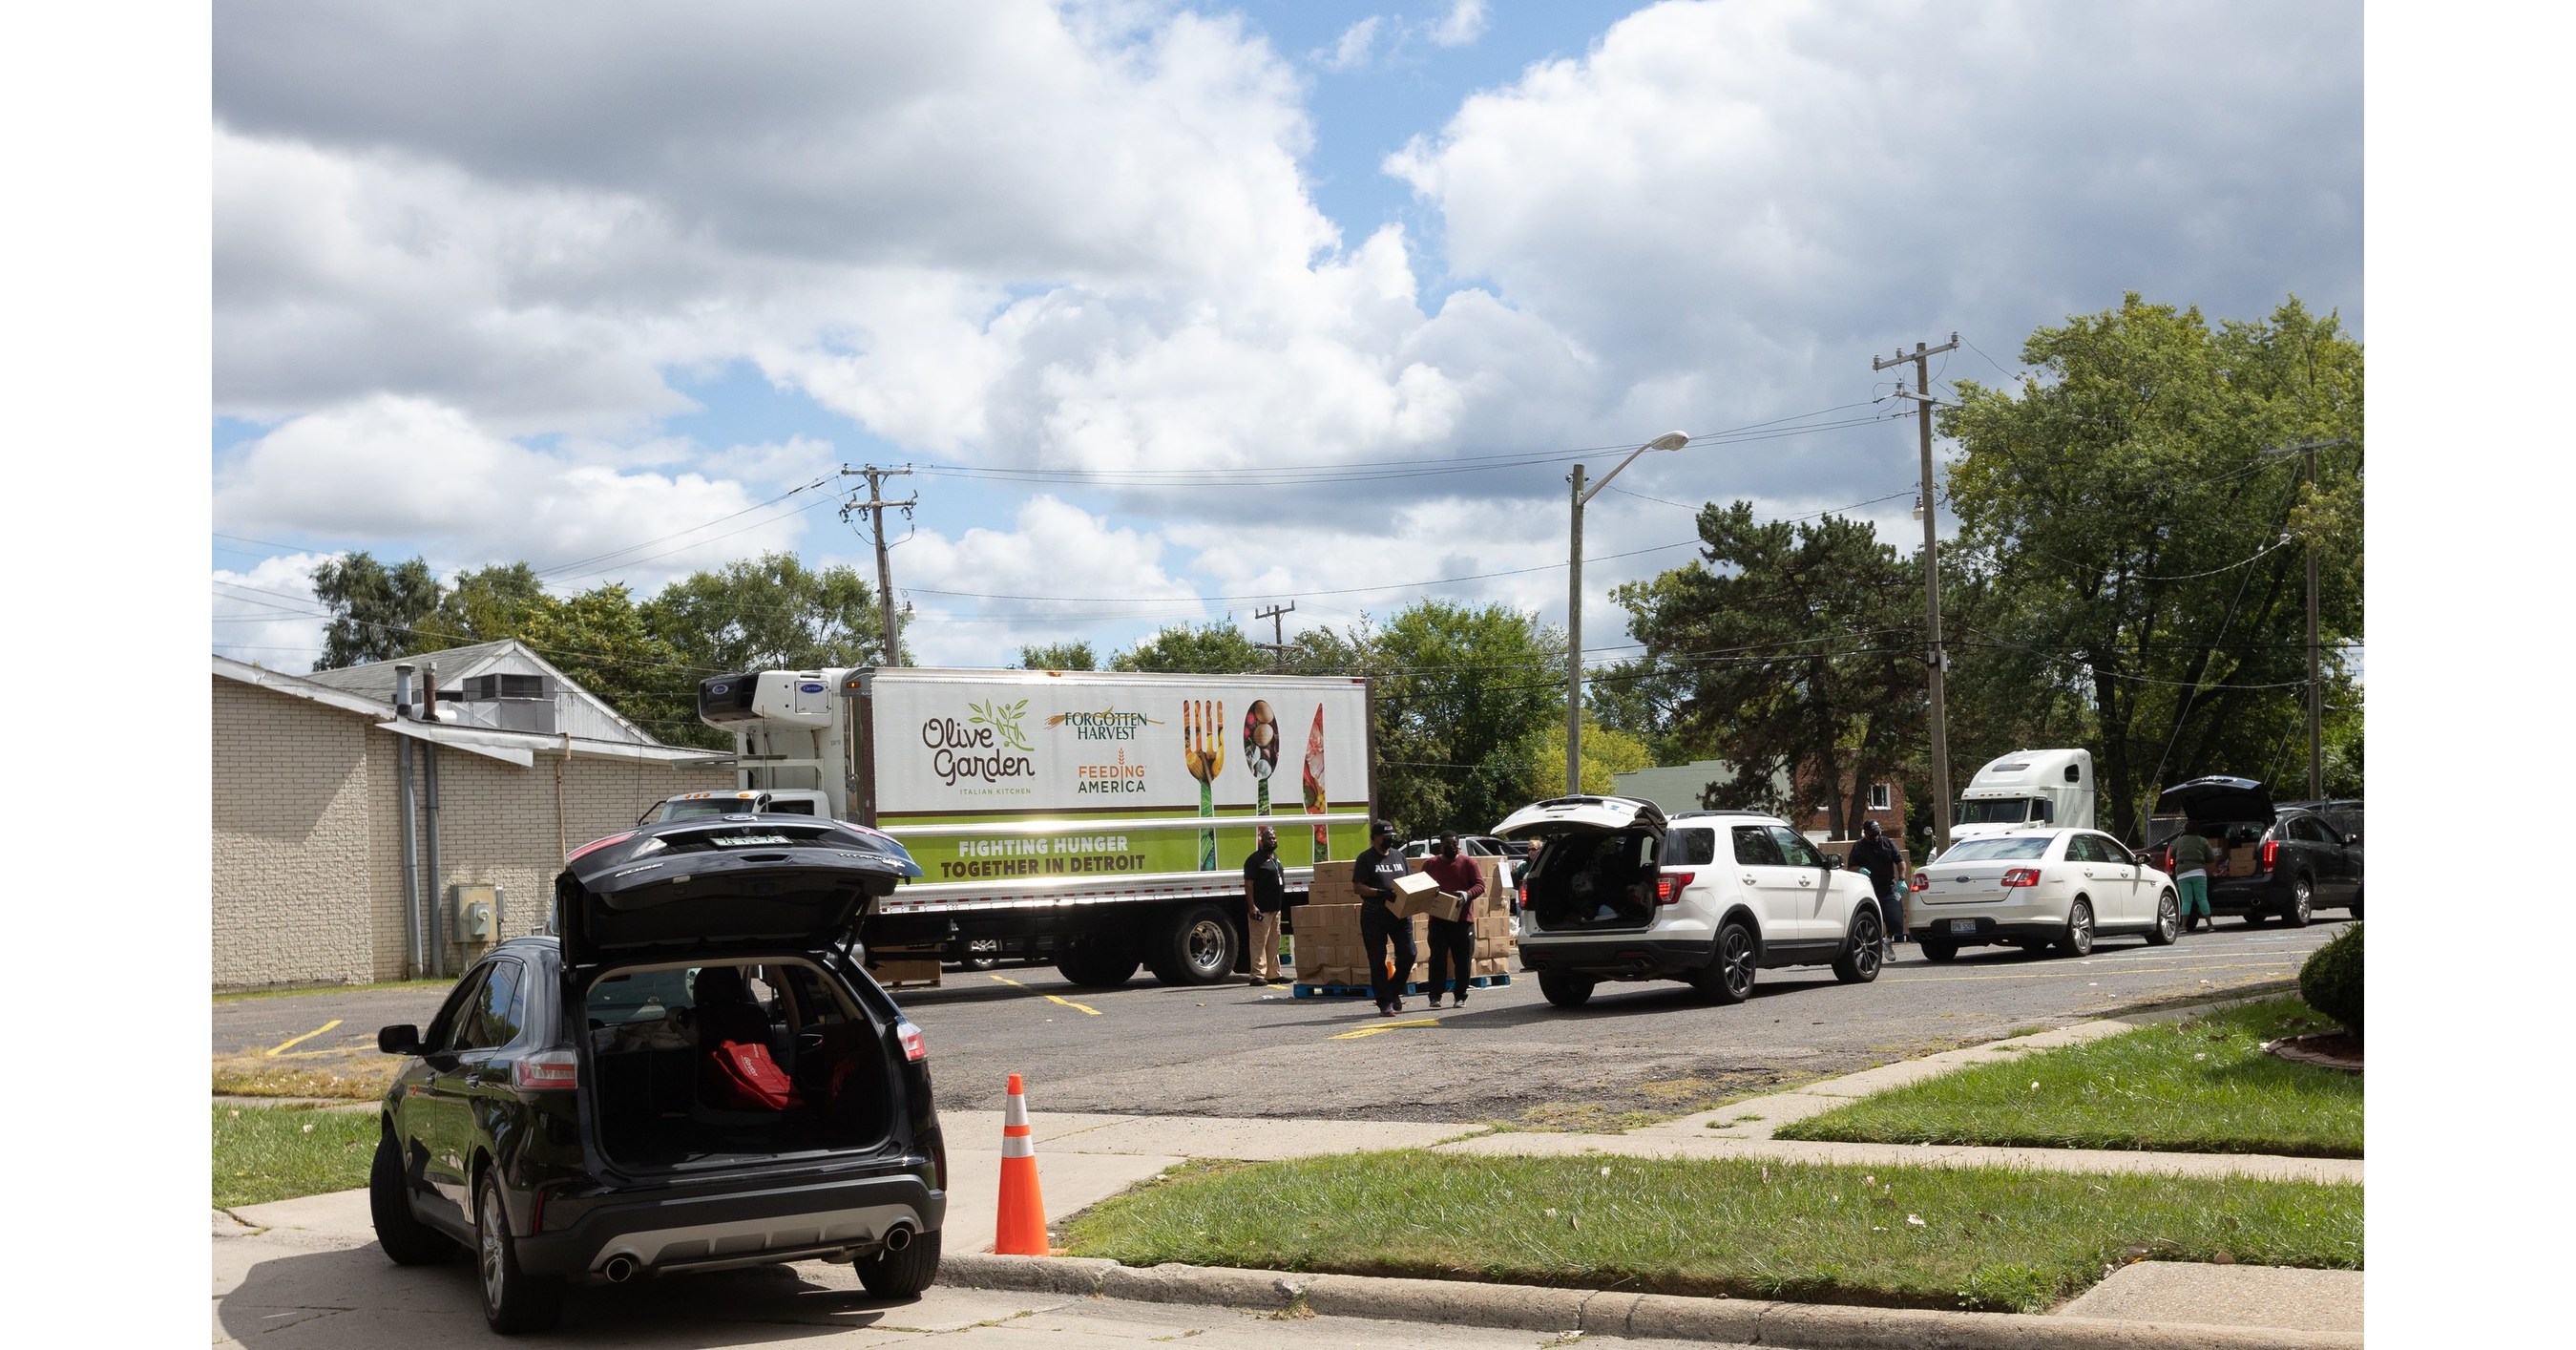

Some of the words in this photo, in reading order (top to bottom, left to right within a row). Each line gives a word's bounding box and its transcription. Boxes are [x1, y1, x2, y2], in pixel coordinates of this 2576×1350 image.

[1065, 711, 1147, 727] FORGOTTEN
[922, 717, 995, 749] Olive
[1078, 726, 1137, 741] HARVEST
[933, 748, 1036, 787] Garden
[1079, 765, 1145, 779] FEEDING
[1078, 780, 1146, 793] AMERICA
[958, 837, 1049, 857] FIGHTING
[1054, 835, 1129, 854] HUNGER
[940, 858, 1040, 878] TOGETHER
[1045, 857, 1065, 874] IN
[1070, 854, 1145, 873] DETROIT
[1374, 863, 1393, 873] ALL
[1393, 863, 1404, 873] IN
